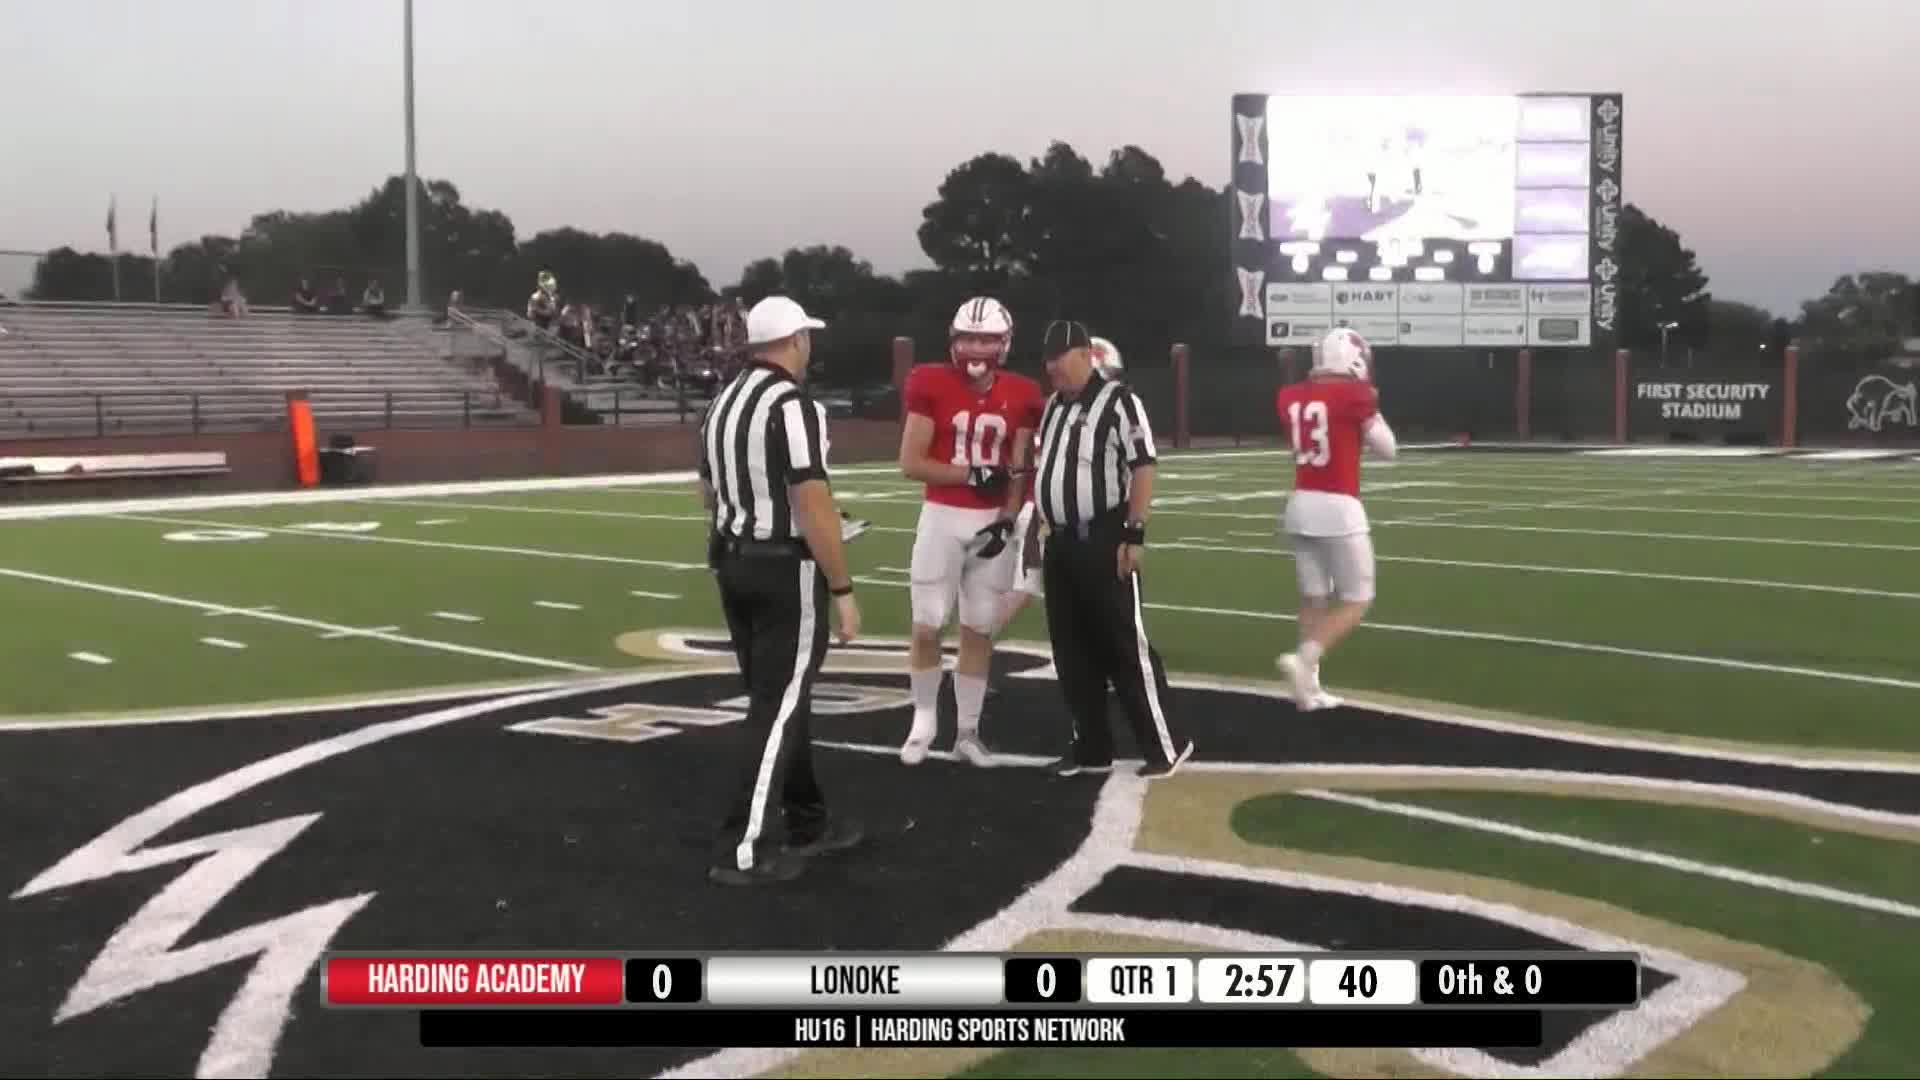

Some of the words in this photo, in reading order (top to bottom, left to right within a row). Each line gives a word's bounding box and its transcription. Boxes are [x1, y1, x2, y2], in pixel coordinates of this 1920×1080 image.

[1598, 124, 1619, 172] Unity
[1597, 204, 1618, 251] Unity
[1597, 284, 1617, 330] Unity
[1637, 384, 1682, 400] FIRST
[1686, 384, 1771, 401] SECURITY
[1661, 402, 1742, 420] STADIUM
[951, 410, 1008, 467] 10
[1288, 400, 1332, 468] 13
